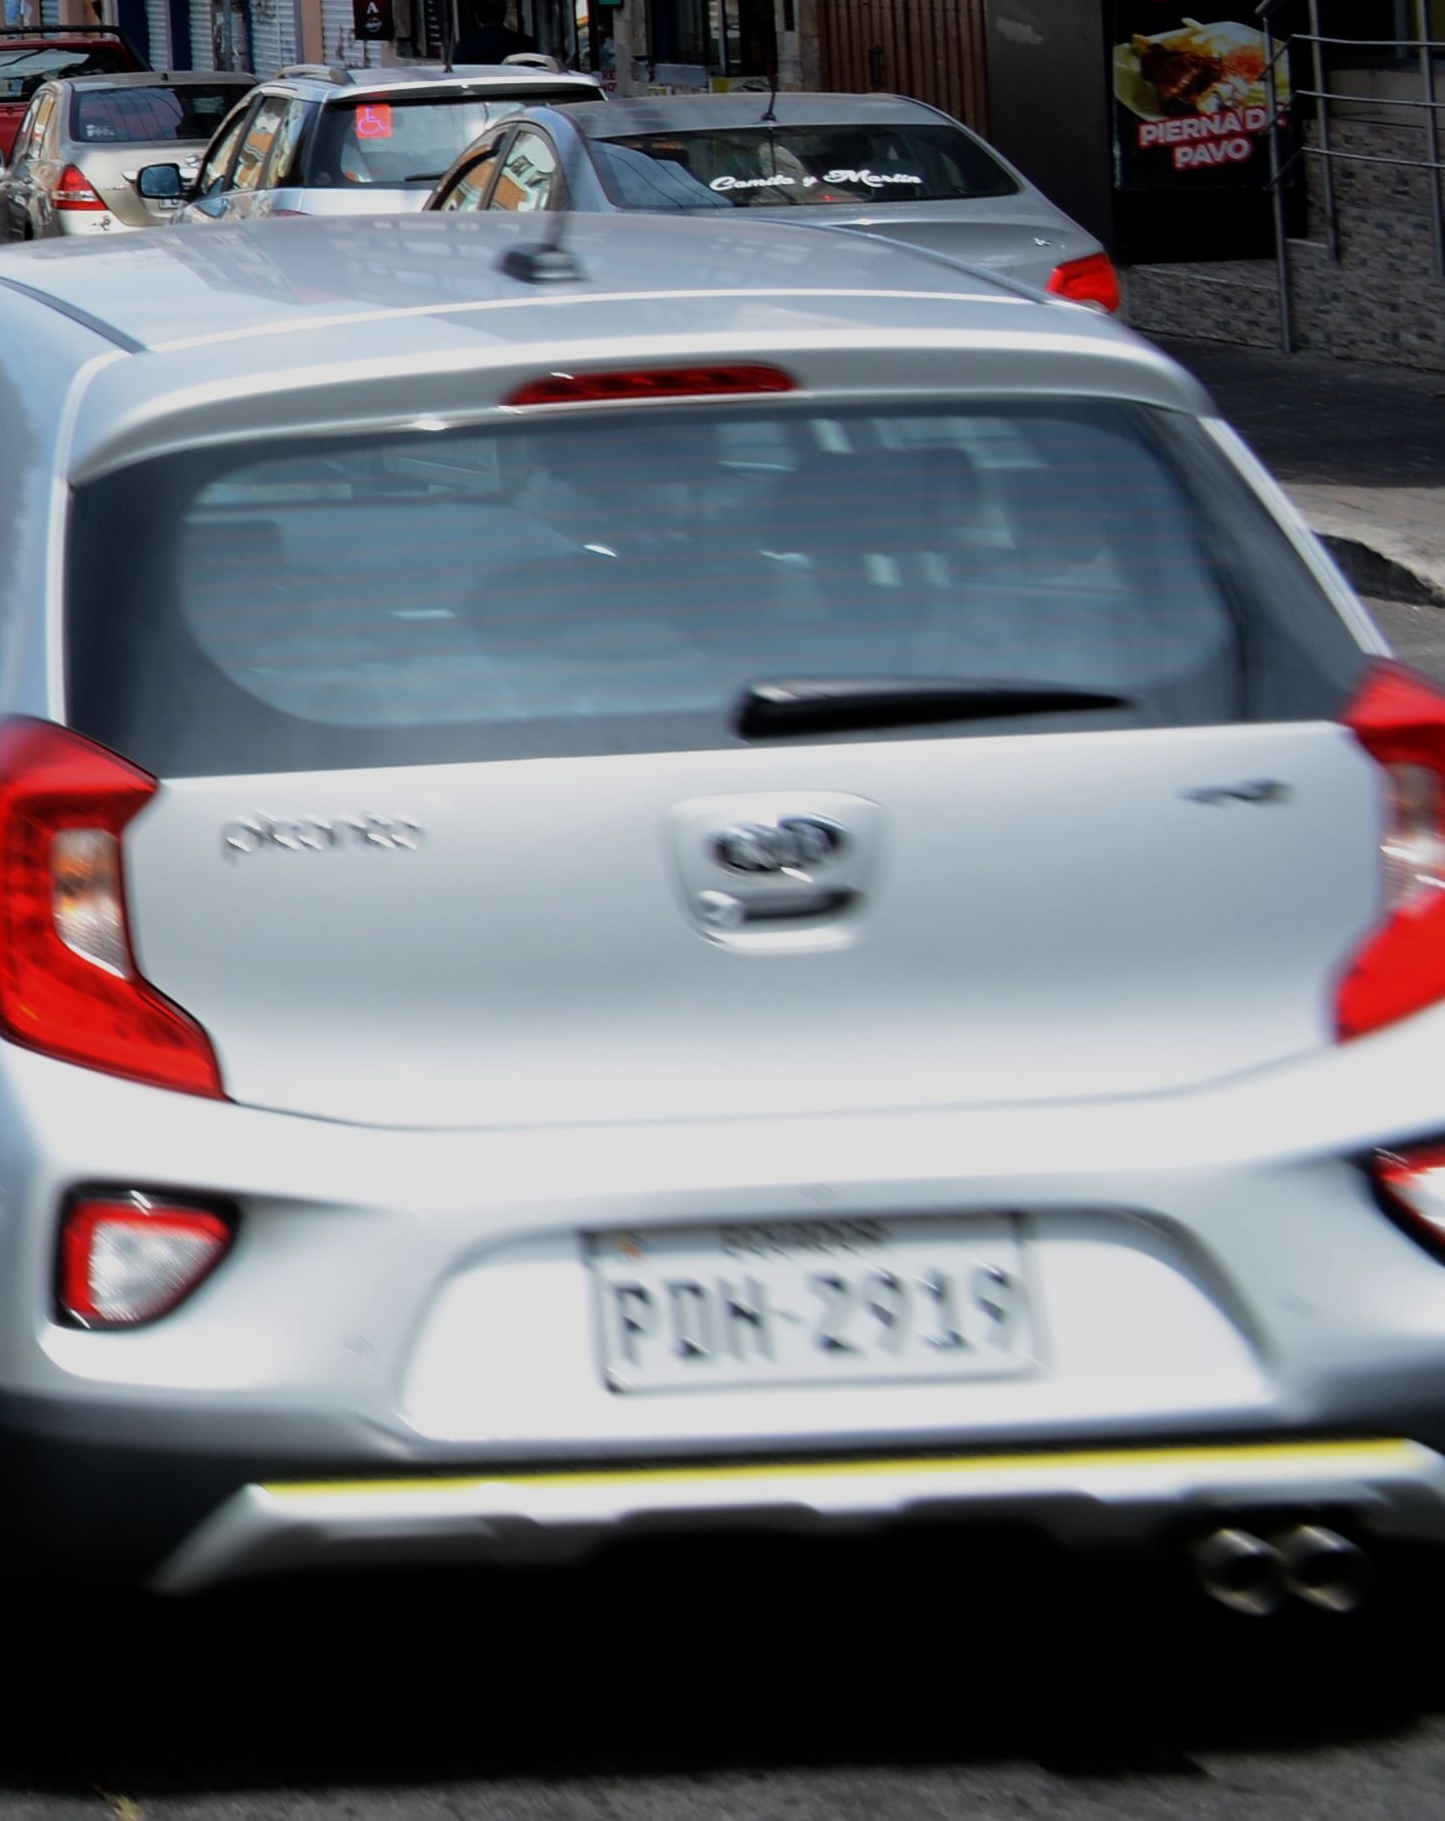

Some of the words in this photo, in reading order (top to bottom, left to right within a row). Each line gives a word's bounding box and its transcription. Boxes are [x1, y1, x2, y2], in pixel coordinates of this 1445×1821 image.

[1139, 111, 1239, 146] PIERNA
[1175, 138, 1250, 169] PAVO
[801, 175, 819, 189] y
[611, 1260, 1024, 1370] PDH-2919
